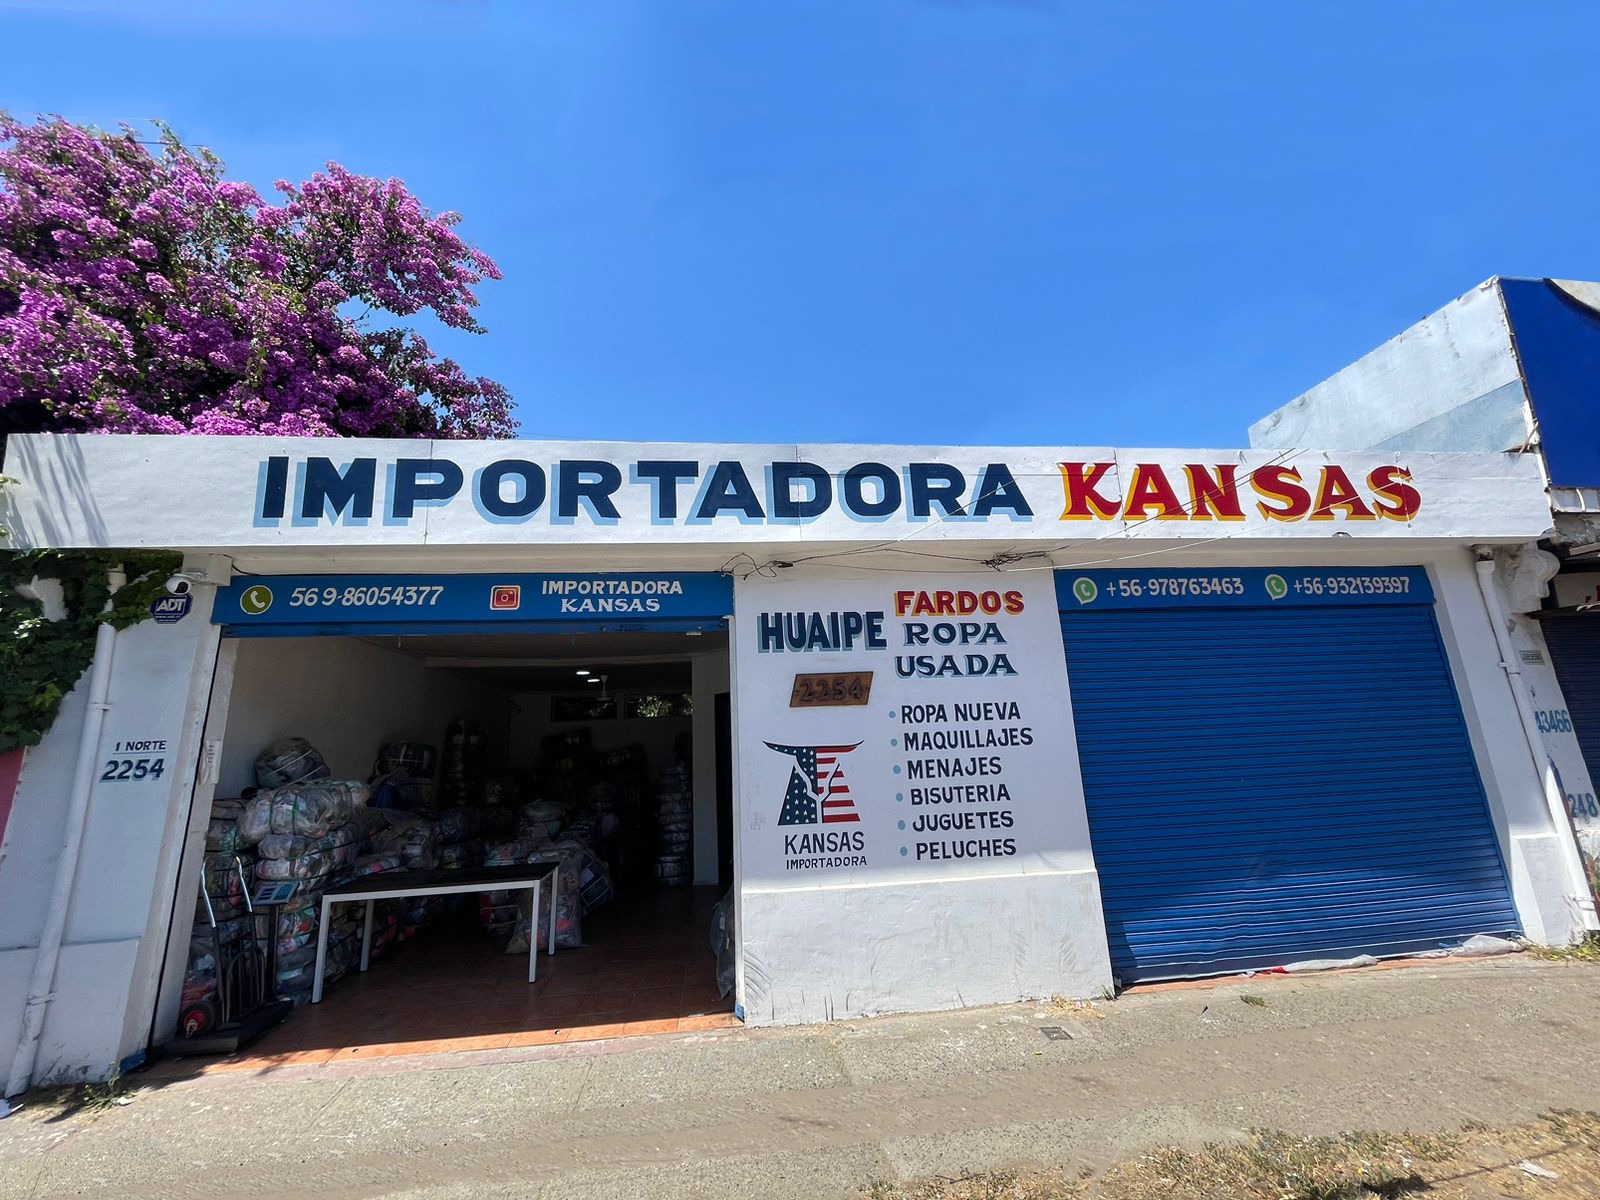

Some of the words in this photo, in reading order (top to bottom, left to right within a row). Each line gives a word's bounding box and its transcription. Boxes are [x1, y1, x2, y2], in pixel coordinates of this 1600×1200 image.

[253, 456, 1034, 527] IMPORTADORA
[1058, 461, 1422, 522] KANSAS
[542, 580, 683, 595] IMPORTADORA
[156, 598, 187, 612] ADT
[560, 598, 661, 613] KANSAS
[894, 590, 1025, 617] FARDOS
[757, 611, 888, 653] HUAIPE
[902, 622, 1008, 647] ROPA
[894, 653, 1019, 679] USADA
[799, 676, 866, 702] 2254
[901, 704, 948, 724] ROPA
[954, 701, 1022, 723] NUEVA
[125, 740, 167, 752] NORTE
[903, 727, 1034, 752] MAQUILLAJES
[99, 758, 165, 784] 2254
[906, 756, 1003, 780] MENAJES
[910, 783, 1012, 806] BISUTERIA
[912, 810, 1015, 832] JUGUETES
[784, 830, 865, 855] KANSAS
[915, 838, 1017, 861] PELUCHES
[785, 855, 868, 871] IMPORTADORA
